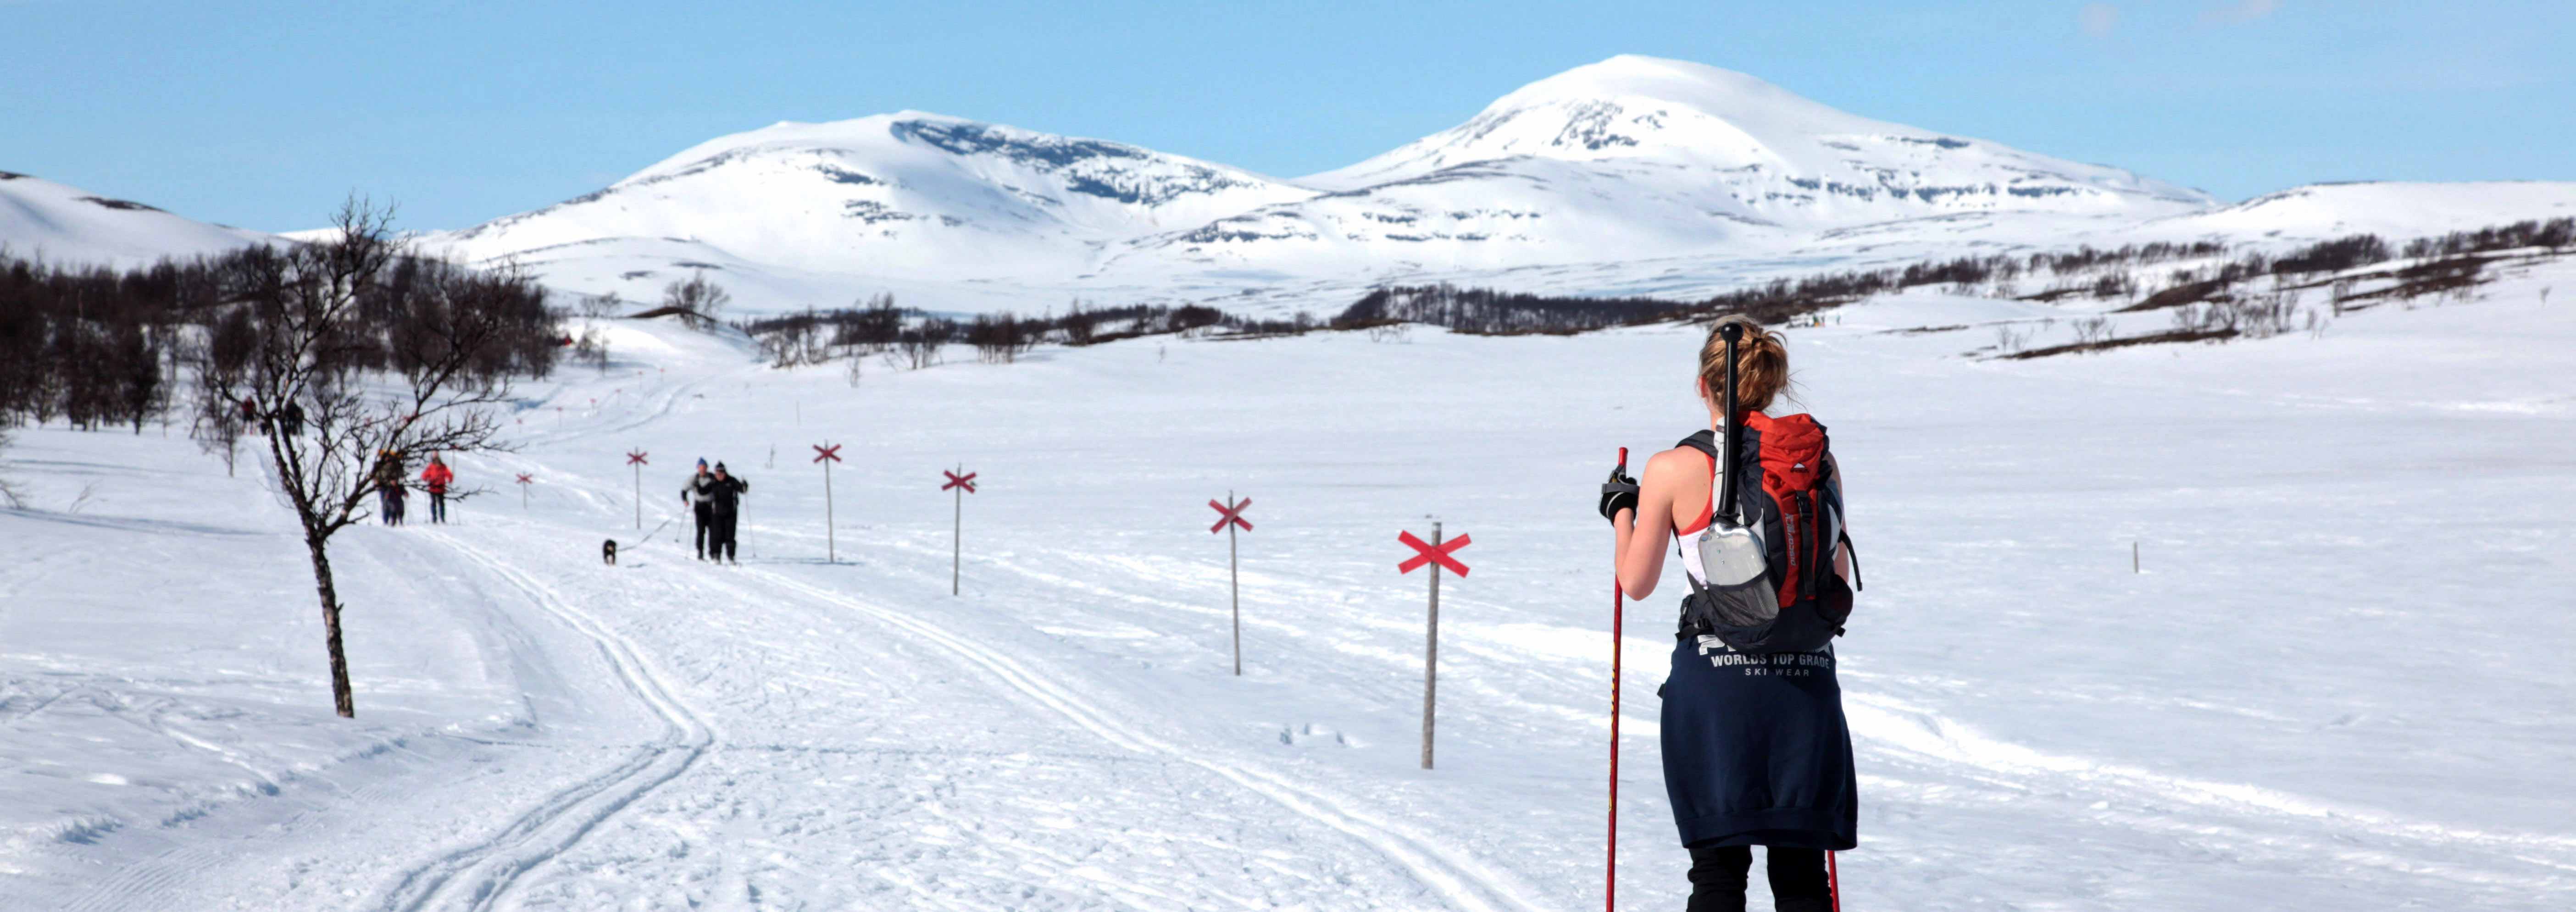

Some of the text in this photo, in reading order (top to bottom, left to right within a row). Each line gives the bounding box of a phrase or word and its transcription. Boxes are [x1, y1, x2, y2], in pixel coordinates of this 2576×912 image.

[1785, 513, 1796, 566] DISCOVERY
[1710, 654, 1829, 669] WORLDS TOP GRADE
